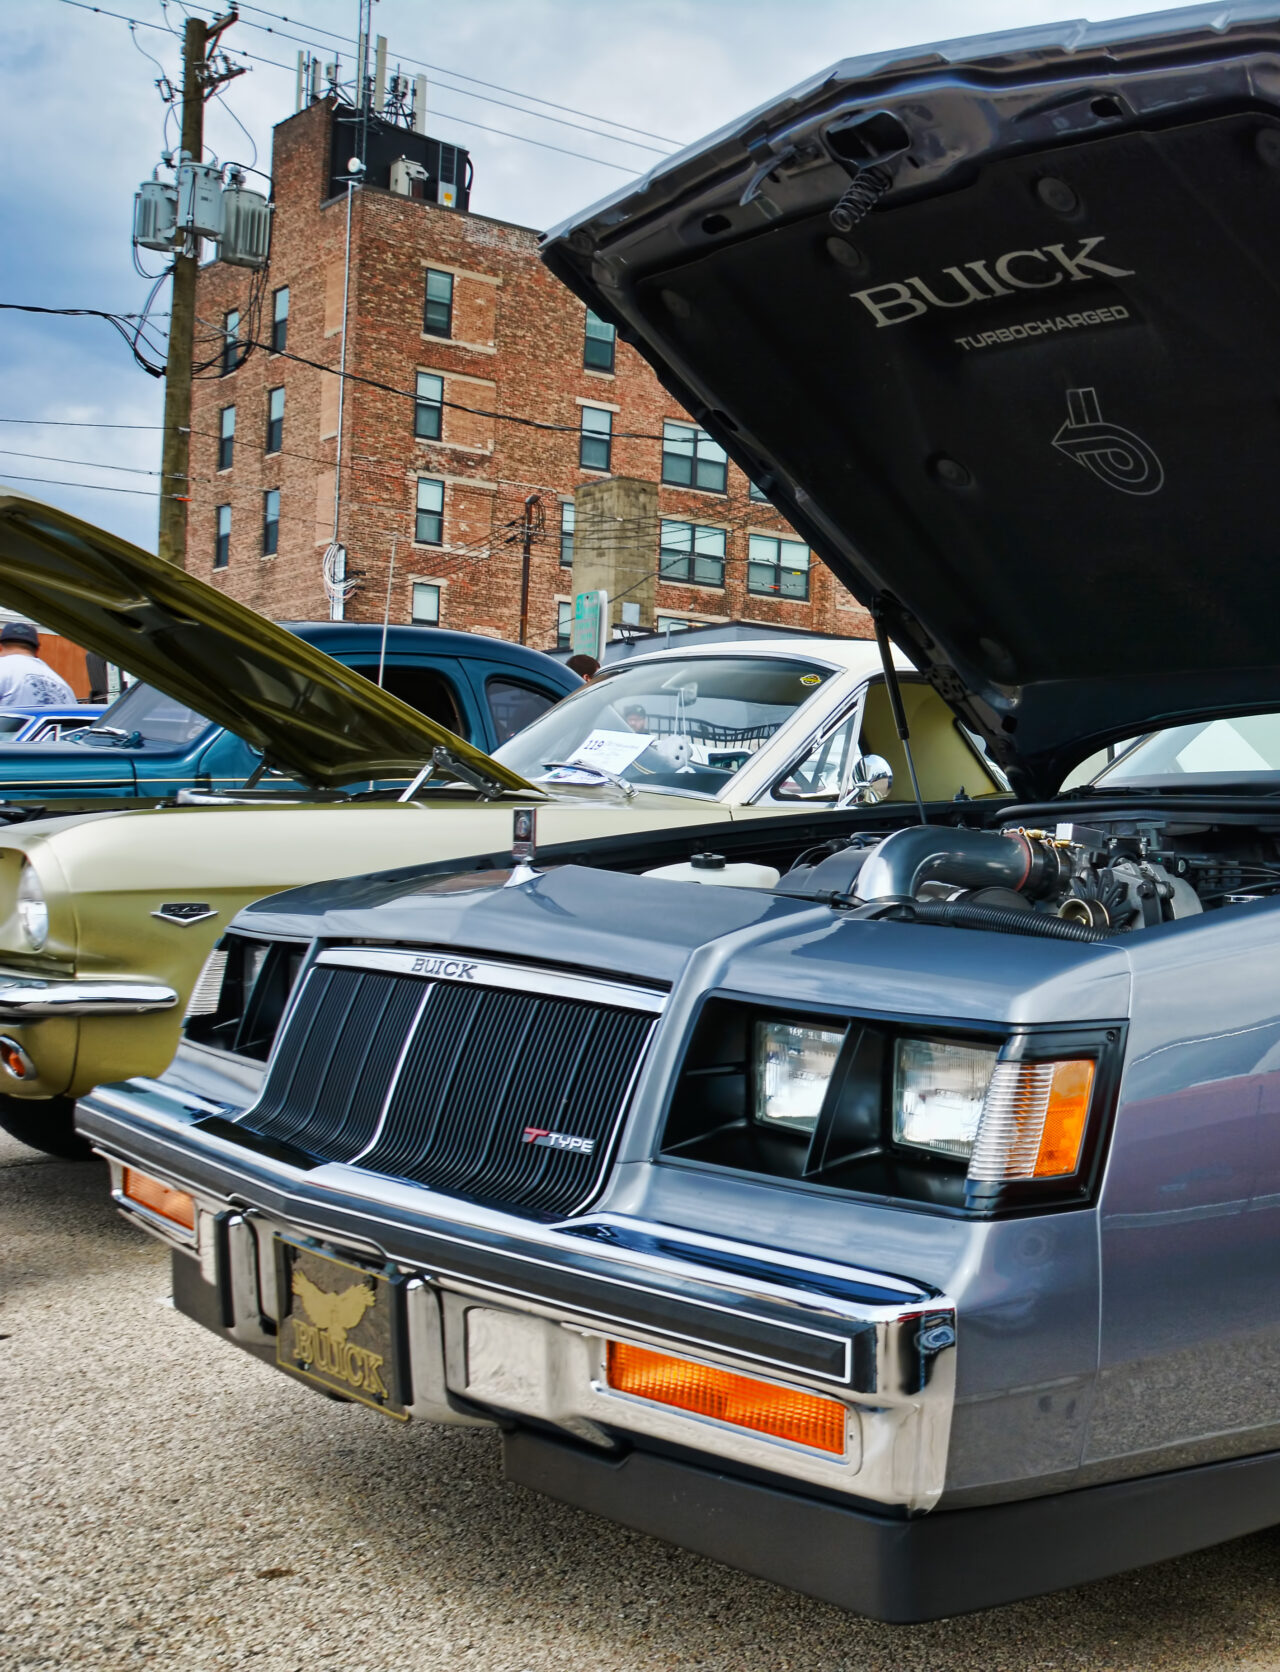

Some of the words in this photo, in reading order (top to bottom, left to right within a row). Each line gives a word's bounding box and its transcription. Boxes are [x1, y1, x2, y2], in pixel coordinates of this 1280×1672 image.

[849, 236, 1136, 328] BUICK
[954, 304, 1130, 350] TURBOCHARGED
[411, 957, 478, 980] BUICK
[548, 1133, 595, 1153] TYPE
[292, 1317, 389, 1399] BUICK
